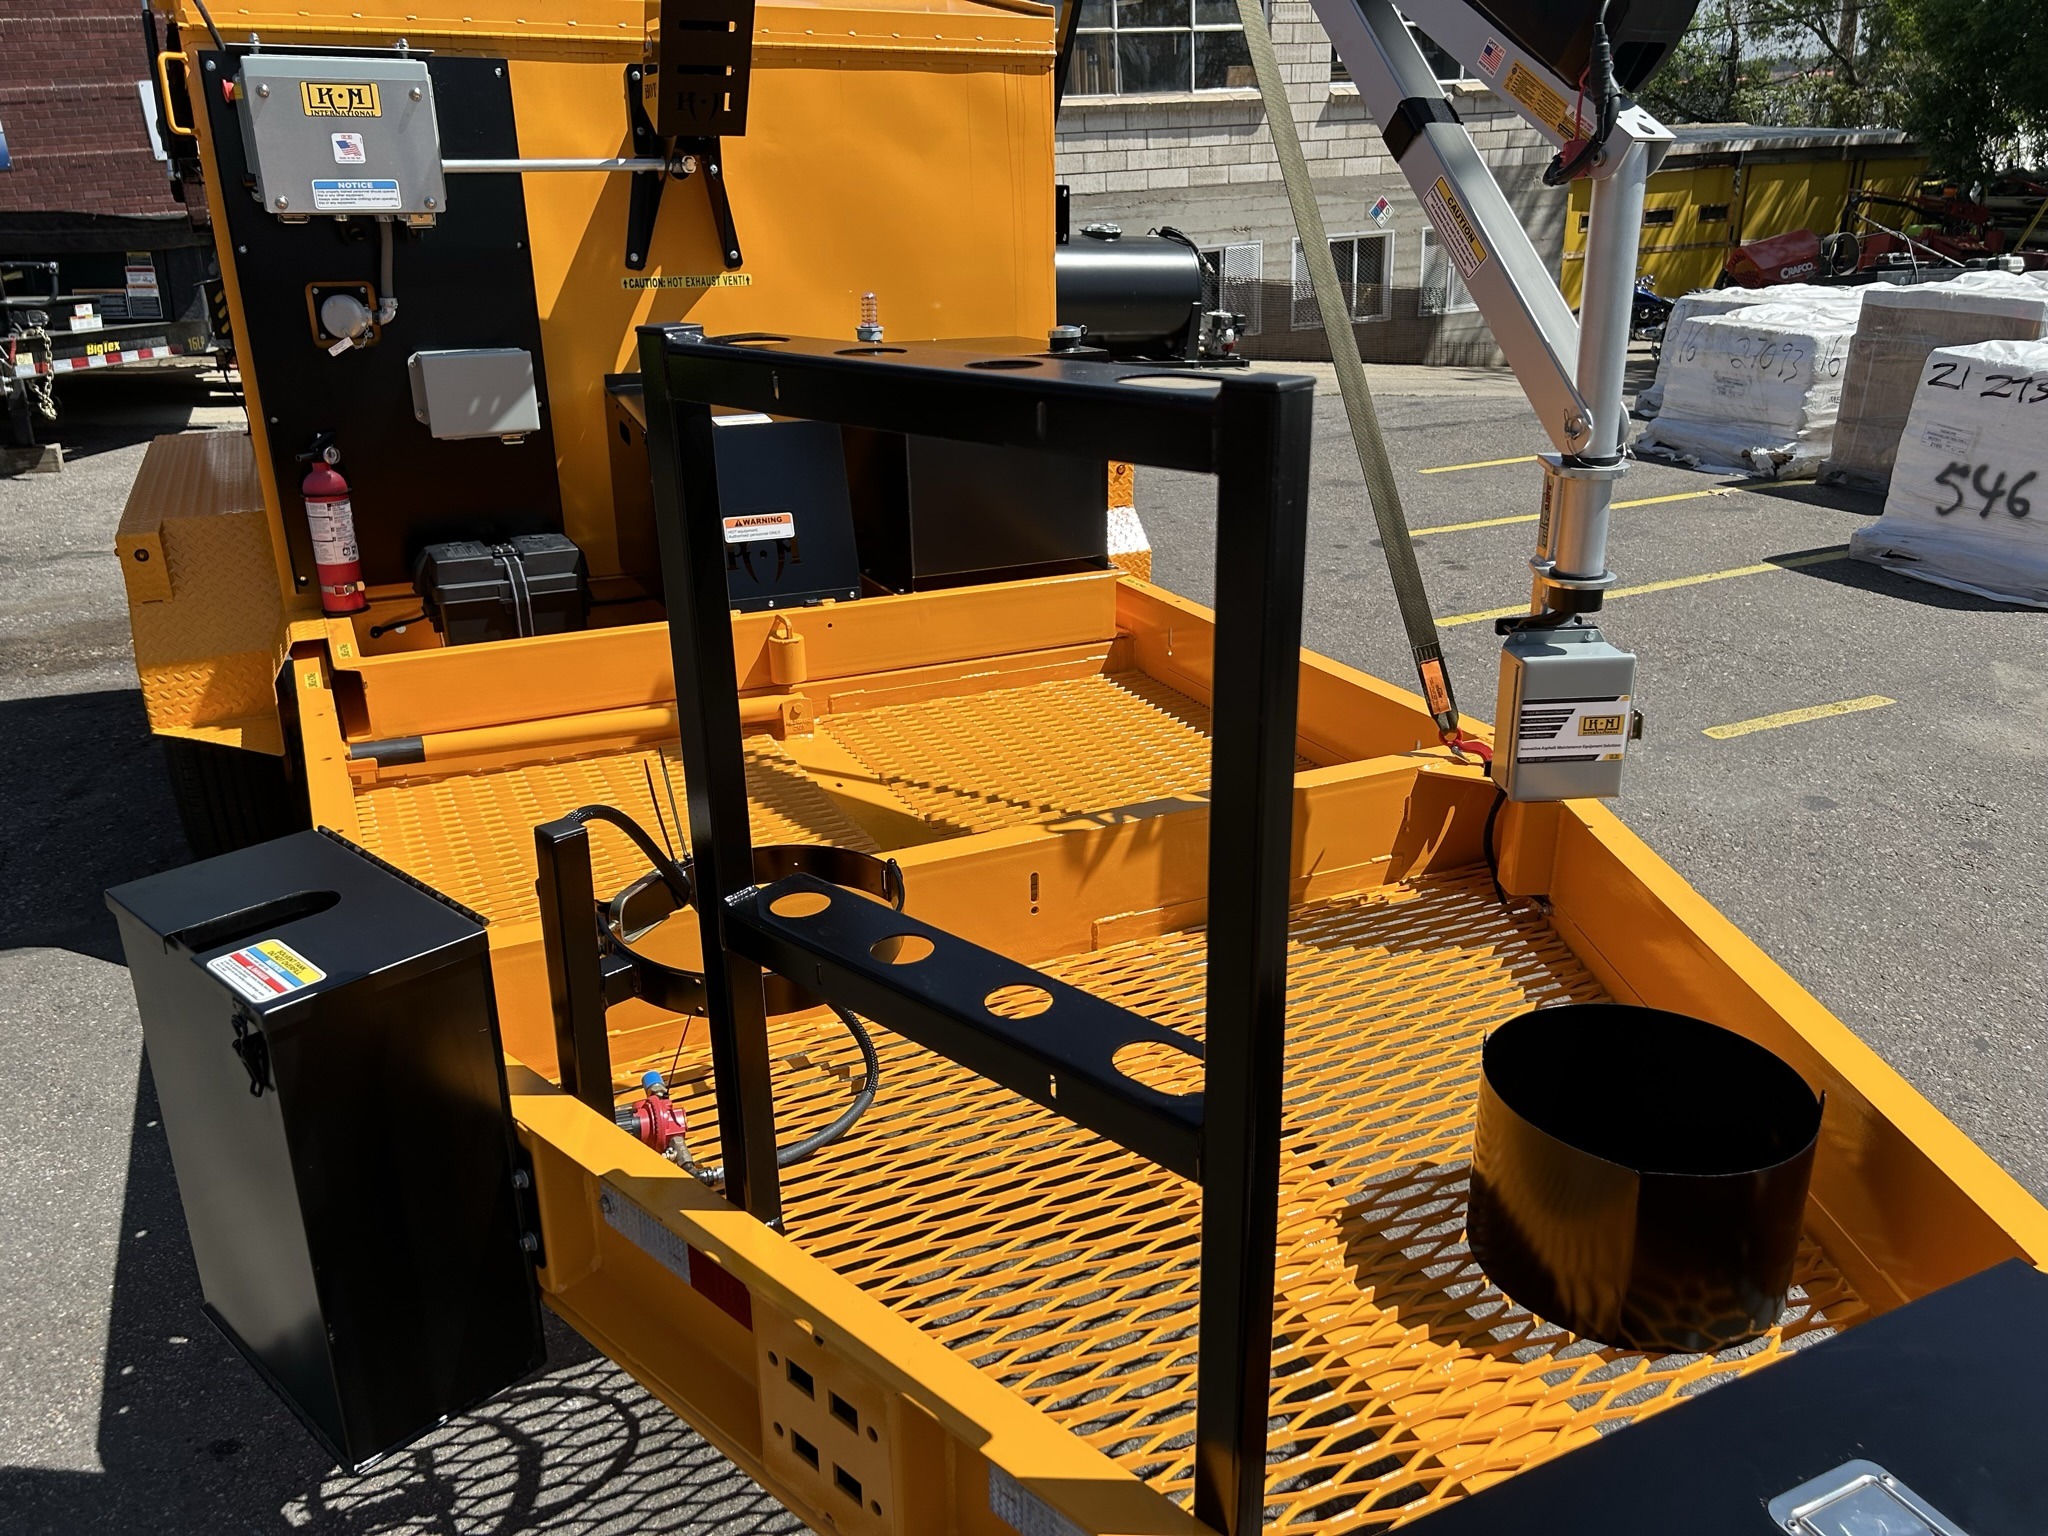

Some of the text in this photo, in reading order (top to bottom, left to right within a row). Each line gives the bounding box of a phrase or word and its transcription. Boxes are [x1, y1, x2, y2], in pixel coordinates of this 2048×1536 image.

[1448, 197, 1475, 244] CAUTION
[1780, 262, 1813, 279] CRAFCO
[628, 275, 745, 288] CAUTION: HOT EXHAUST VENT!
[86, 341, 120, 356] BigTex
[1820, 335, 1843, 377] 16
[1928, 362, 1970, 390] 21
[1935, 462, 2038, 518] 546
[743, 516, 782, 526] WARNING
[276, 950, 297, 963] SOLVENT
[294, 961, 308, 971] TANK
